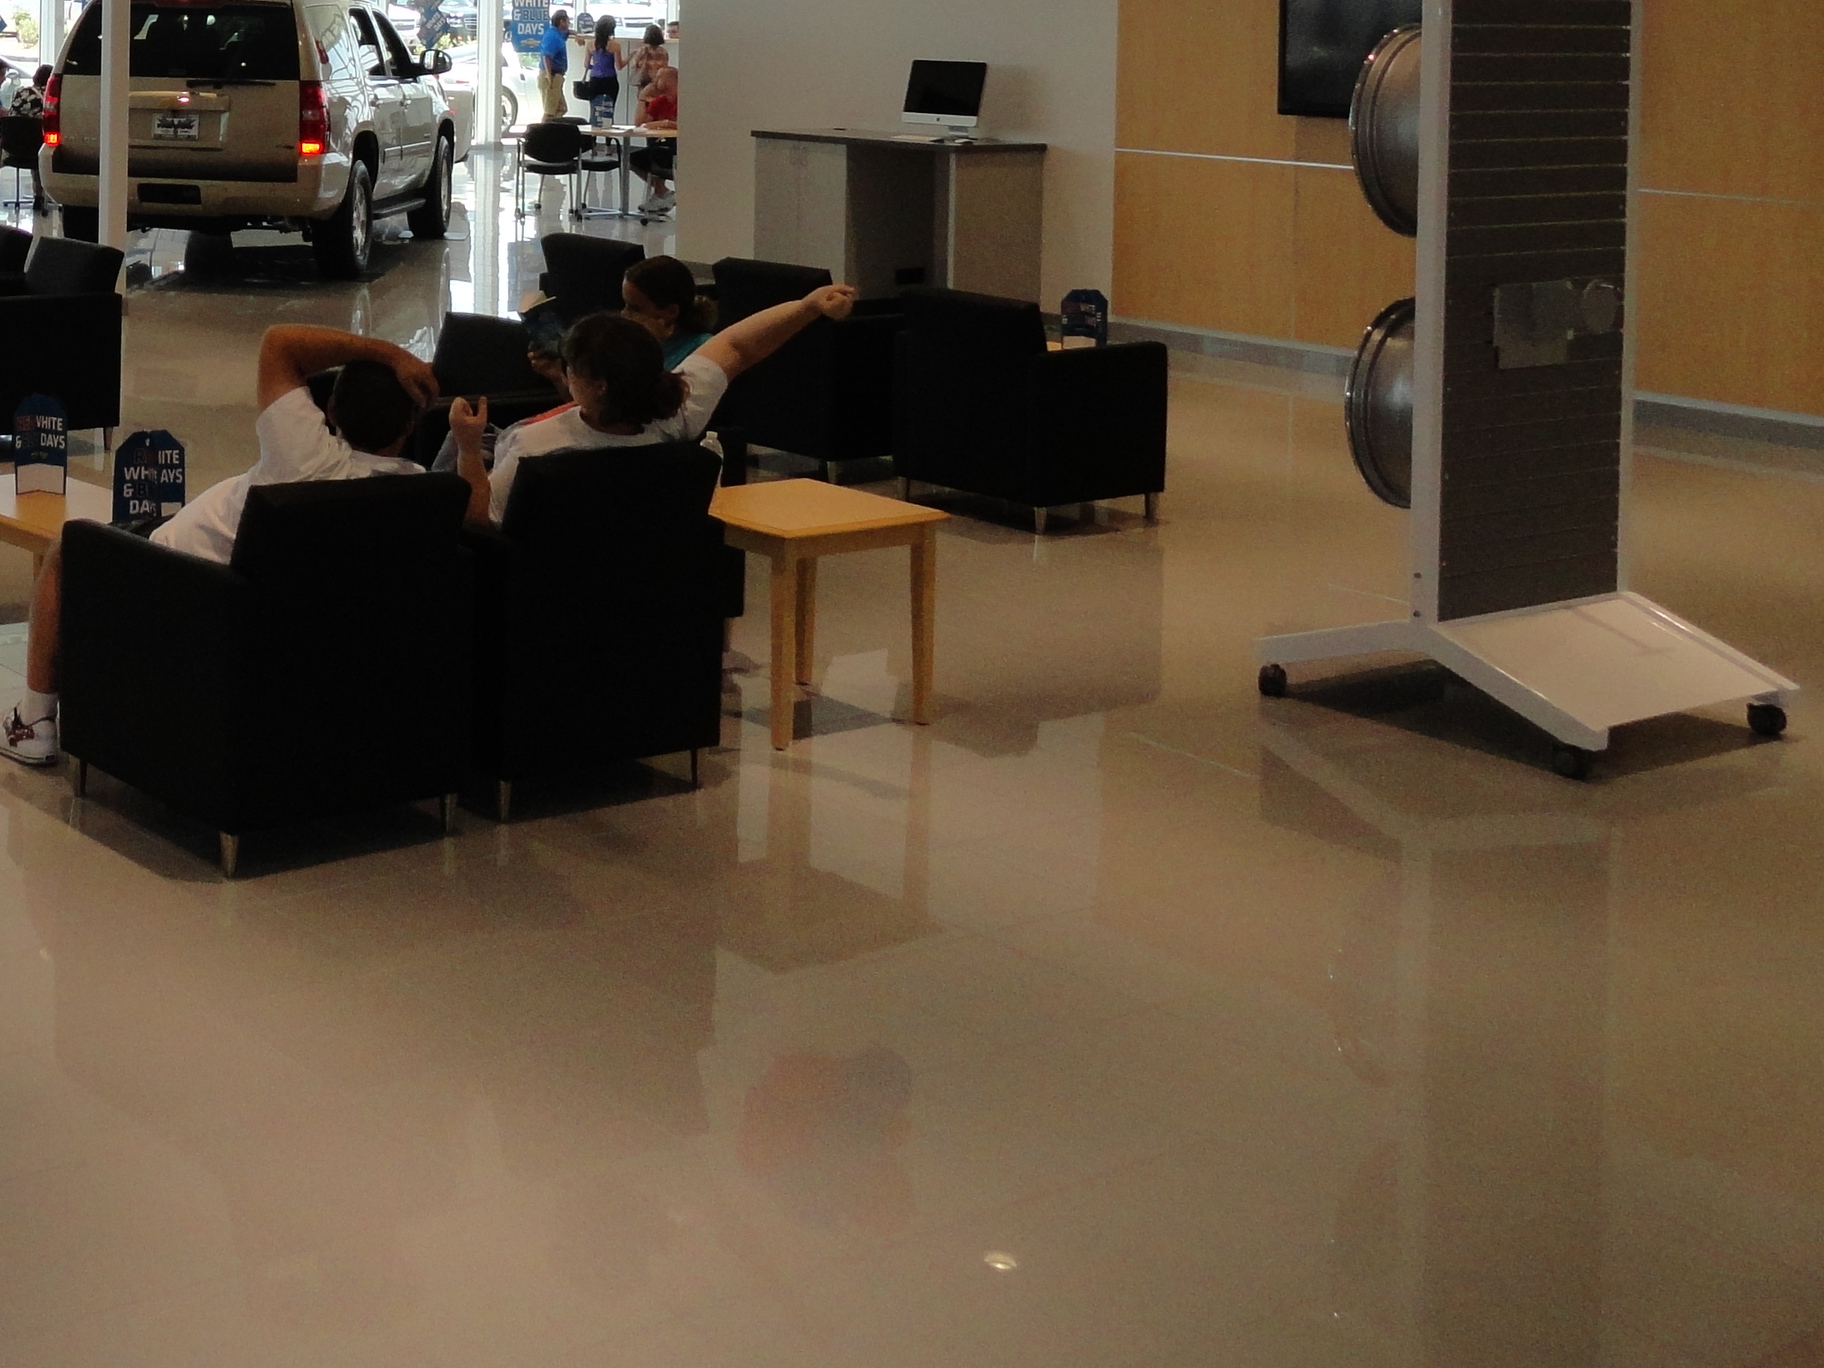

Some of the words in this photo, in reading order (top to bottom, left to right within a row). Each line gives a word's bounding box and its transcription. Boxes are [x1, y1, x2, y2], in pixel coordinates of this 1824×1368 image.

[514, 9, 522, 20] &
[523, 9, 549, 21] BLUE
[518, 23, 544, 35] DAYS
[15, 435, 21, 449] &
[40, 434, 65, 449] DAYS
[160, 468, 183, 483] AYS
[123, 484, 134, 497] &
